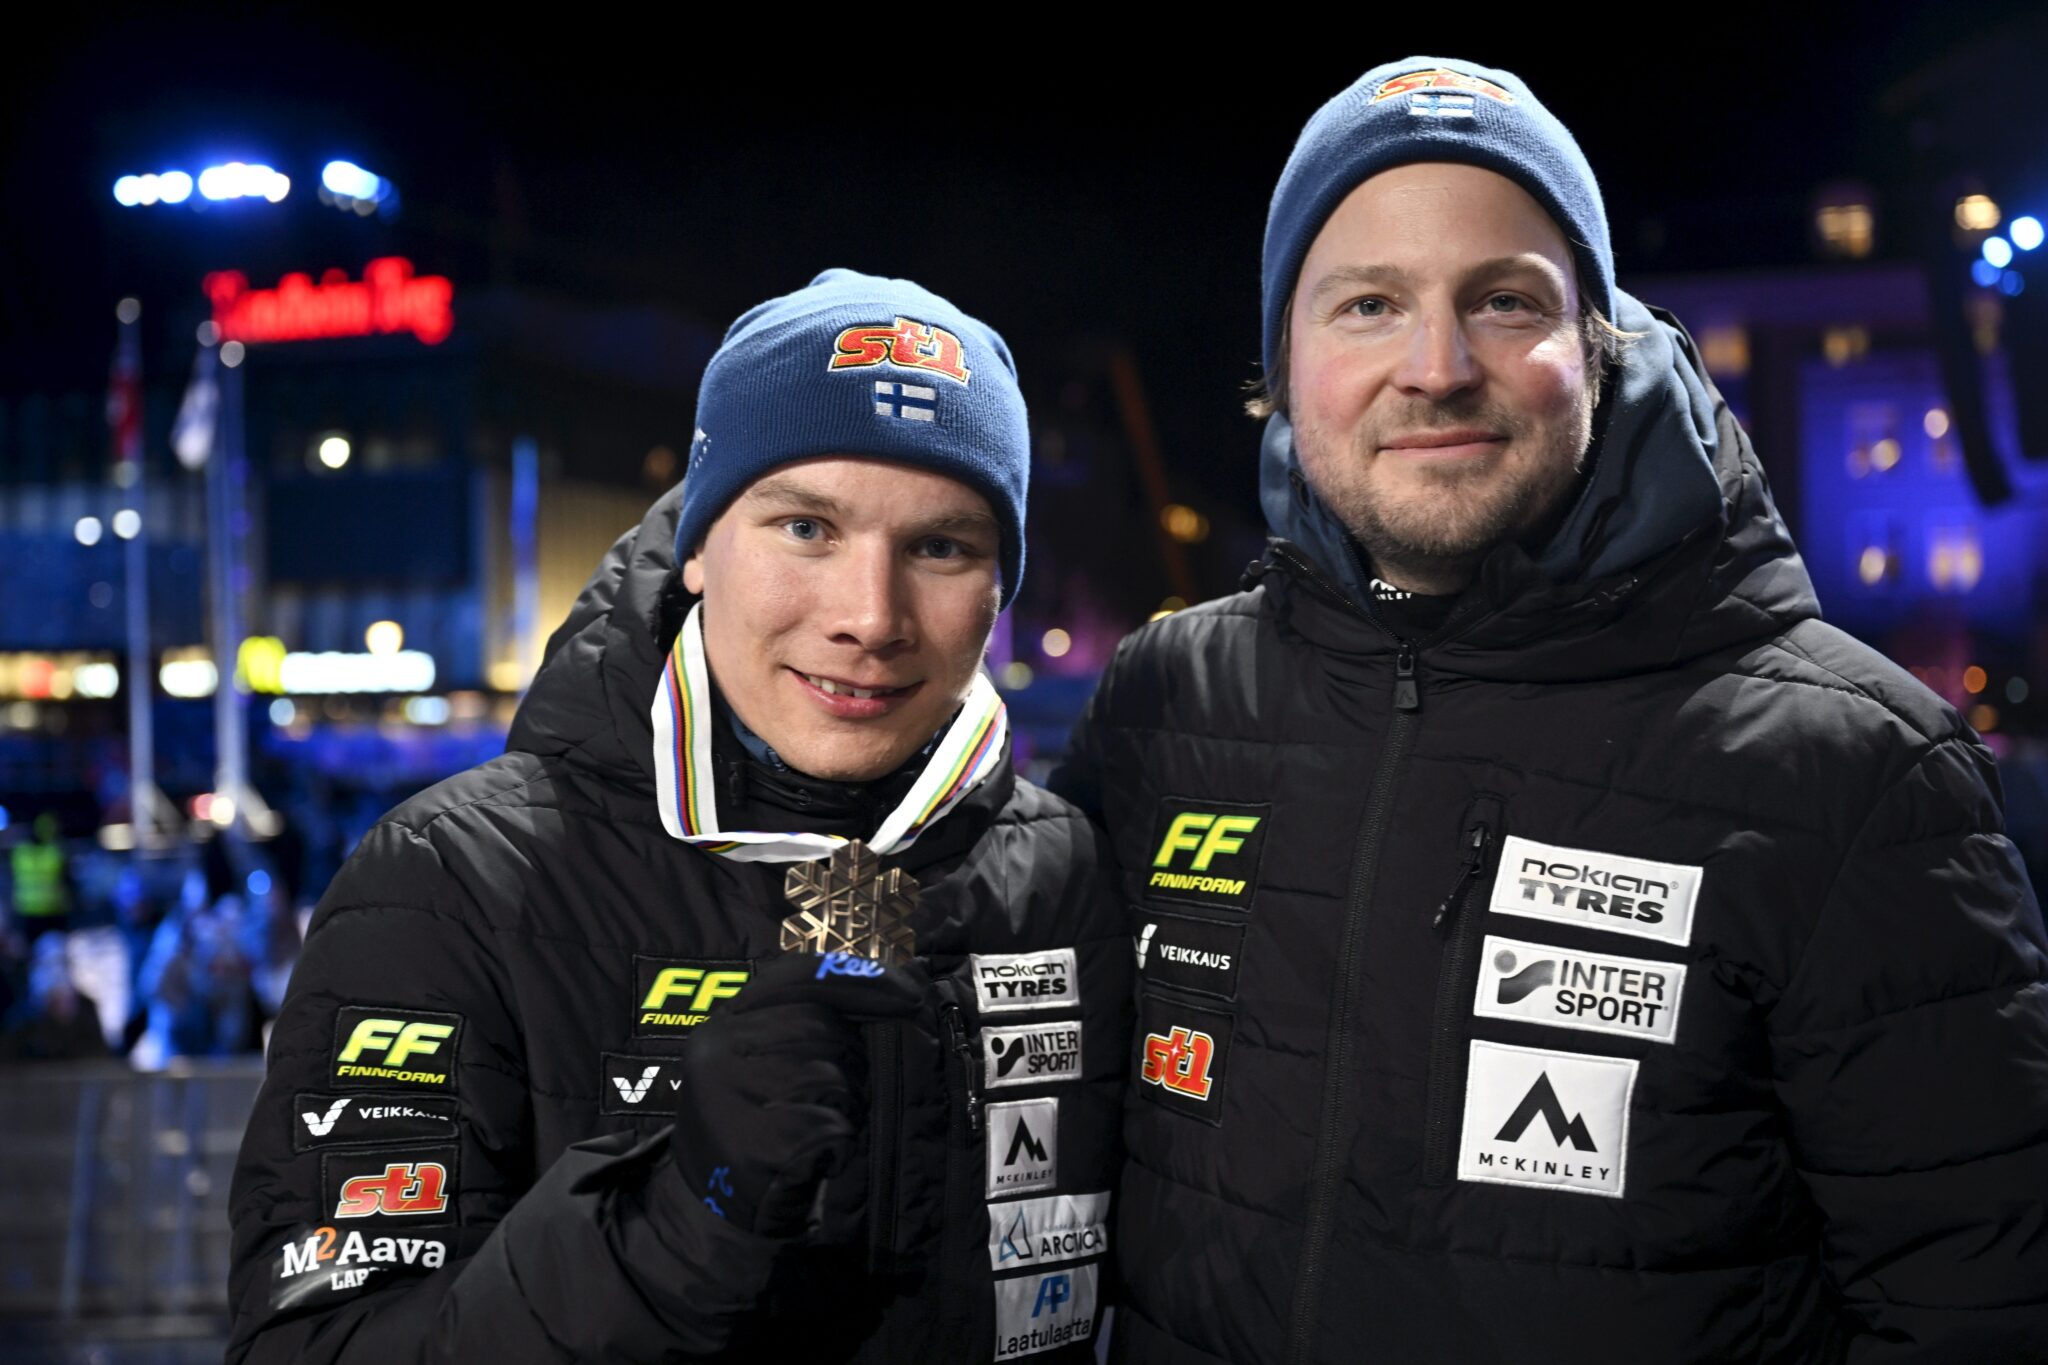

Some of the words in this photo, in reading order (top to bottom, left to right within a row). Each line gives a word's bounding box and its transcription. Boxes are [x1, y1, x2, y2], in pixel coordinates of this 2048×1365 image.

[828, 317, 971, 386] st1
[1152, 812, 1262, 871] FF
[1150, 872, 1246, 895] FINNFORM
[1519, 877, 1665, 924] TYRES
[1160, 944, 1232, 970] VEIKKAUS
[640, 968, 749, 1011] FF
[984, 978, 1067, 998] TYRES
[1559, 959, 1667, 1001] INTER
[640, 1013, 712, 1026] FINNF
[1555, 990, 1663, 1027] SPORT
[337, 1018, 456, 1067] FF
[1026, 1031, 1078, 1054] INTER
[1028, 1051, 1079, 1074] SPORT
[1141, 1025, 1214, 1101] st1
[337, 1065, 446, 1084] FINNFORM
[334, 1162, 449, 1219] st1
[1031, 1274, 1071, 1318] AP
